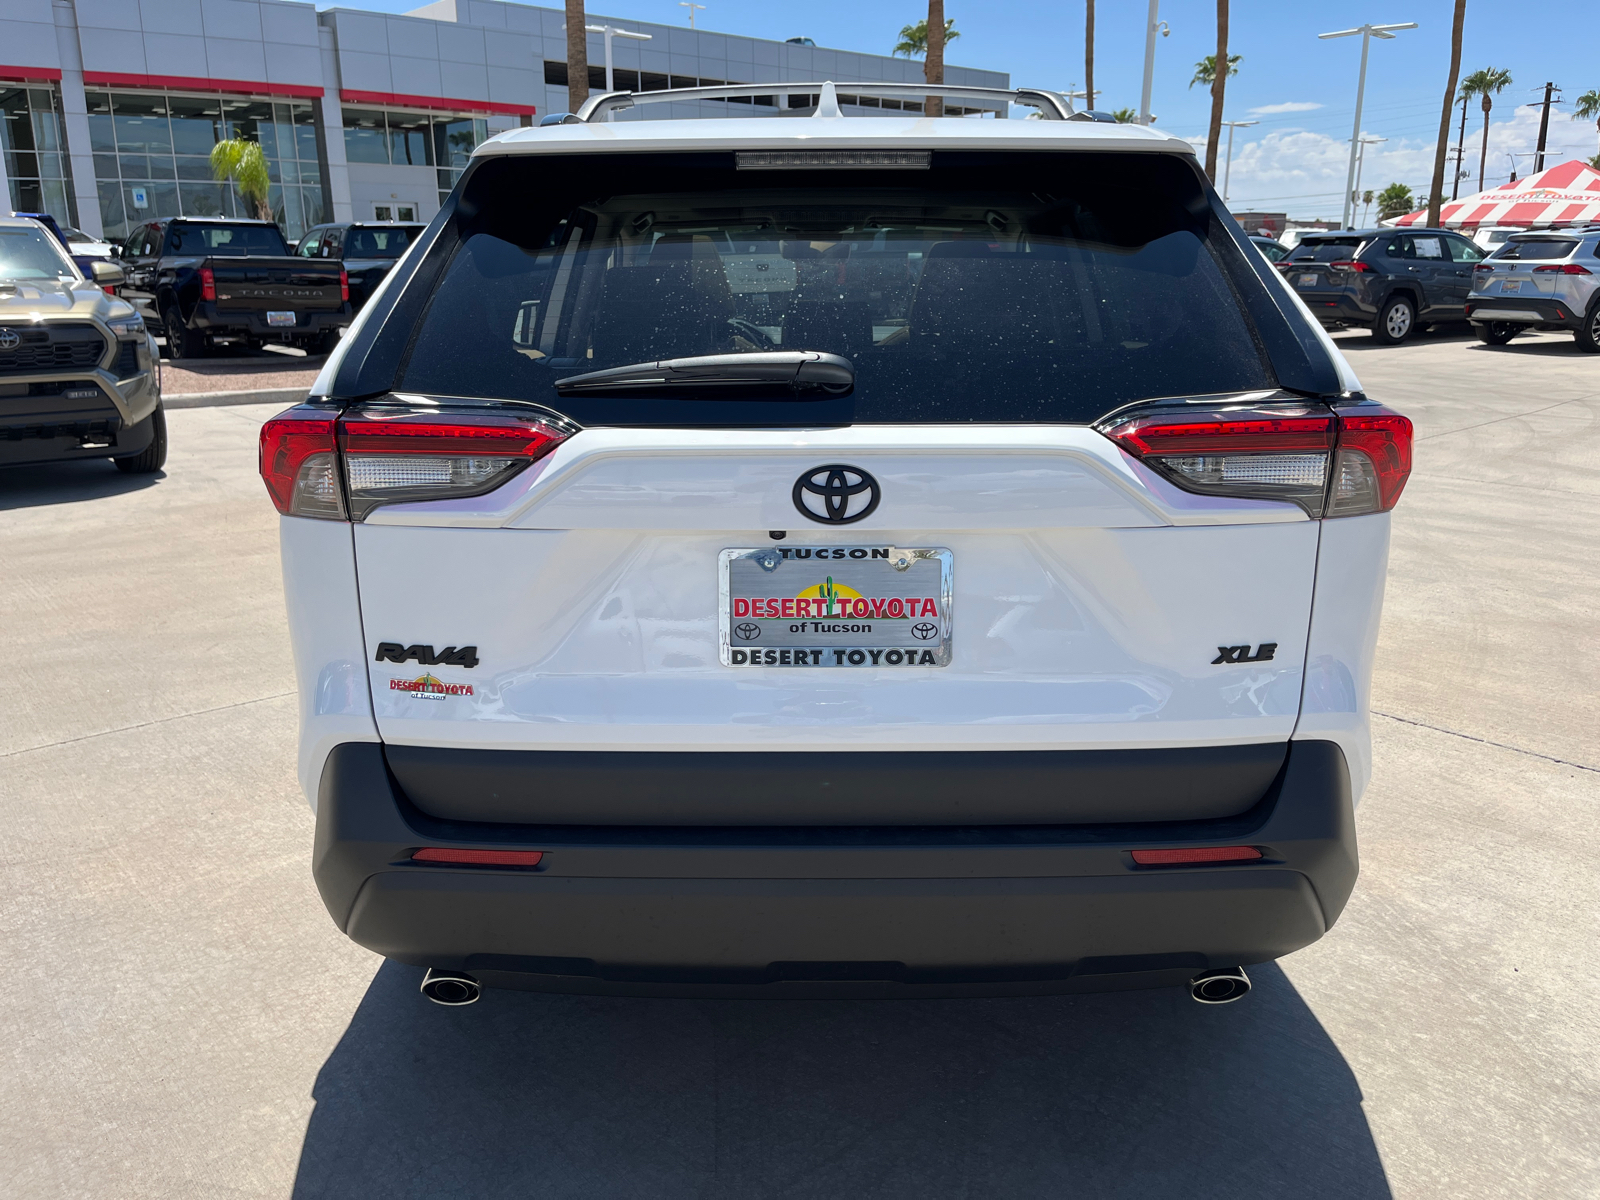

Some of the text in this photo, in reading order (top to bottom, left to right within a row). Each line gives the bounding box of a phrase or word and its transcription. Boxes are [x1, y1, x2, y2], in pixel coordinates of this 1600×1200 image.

[779, 548, 890, 559] TUCSON
[733, 597, 938, 618] DESERT TOYOTA
[789, 621, 872, 633] of Tucson
[375, 642, 480, 668] RAV4
[732, 649, 936, 665] DESERT TOYOTA
[1211, 642, 1278, 665] XLE
[389, 679, 474, 695] DESERT TOYOTA
[420, 693, 446, 701] Tucson
